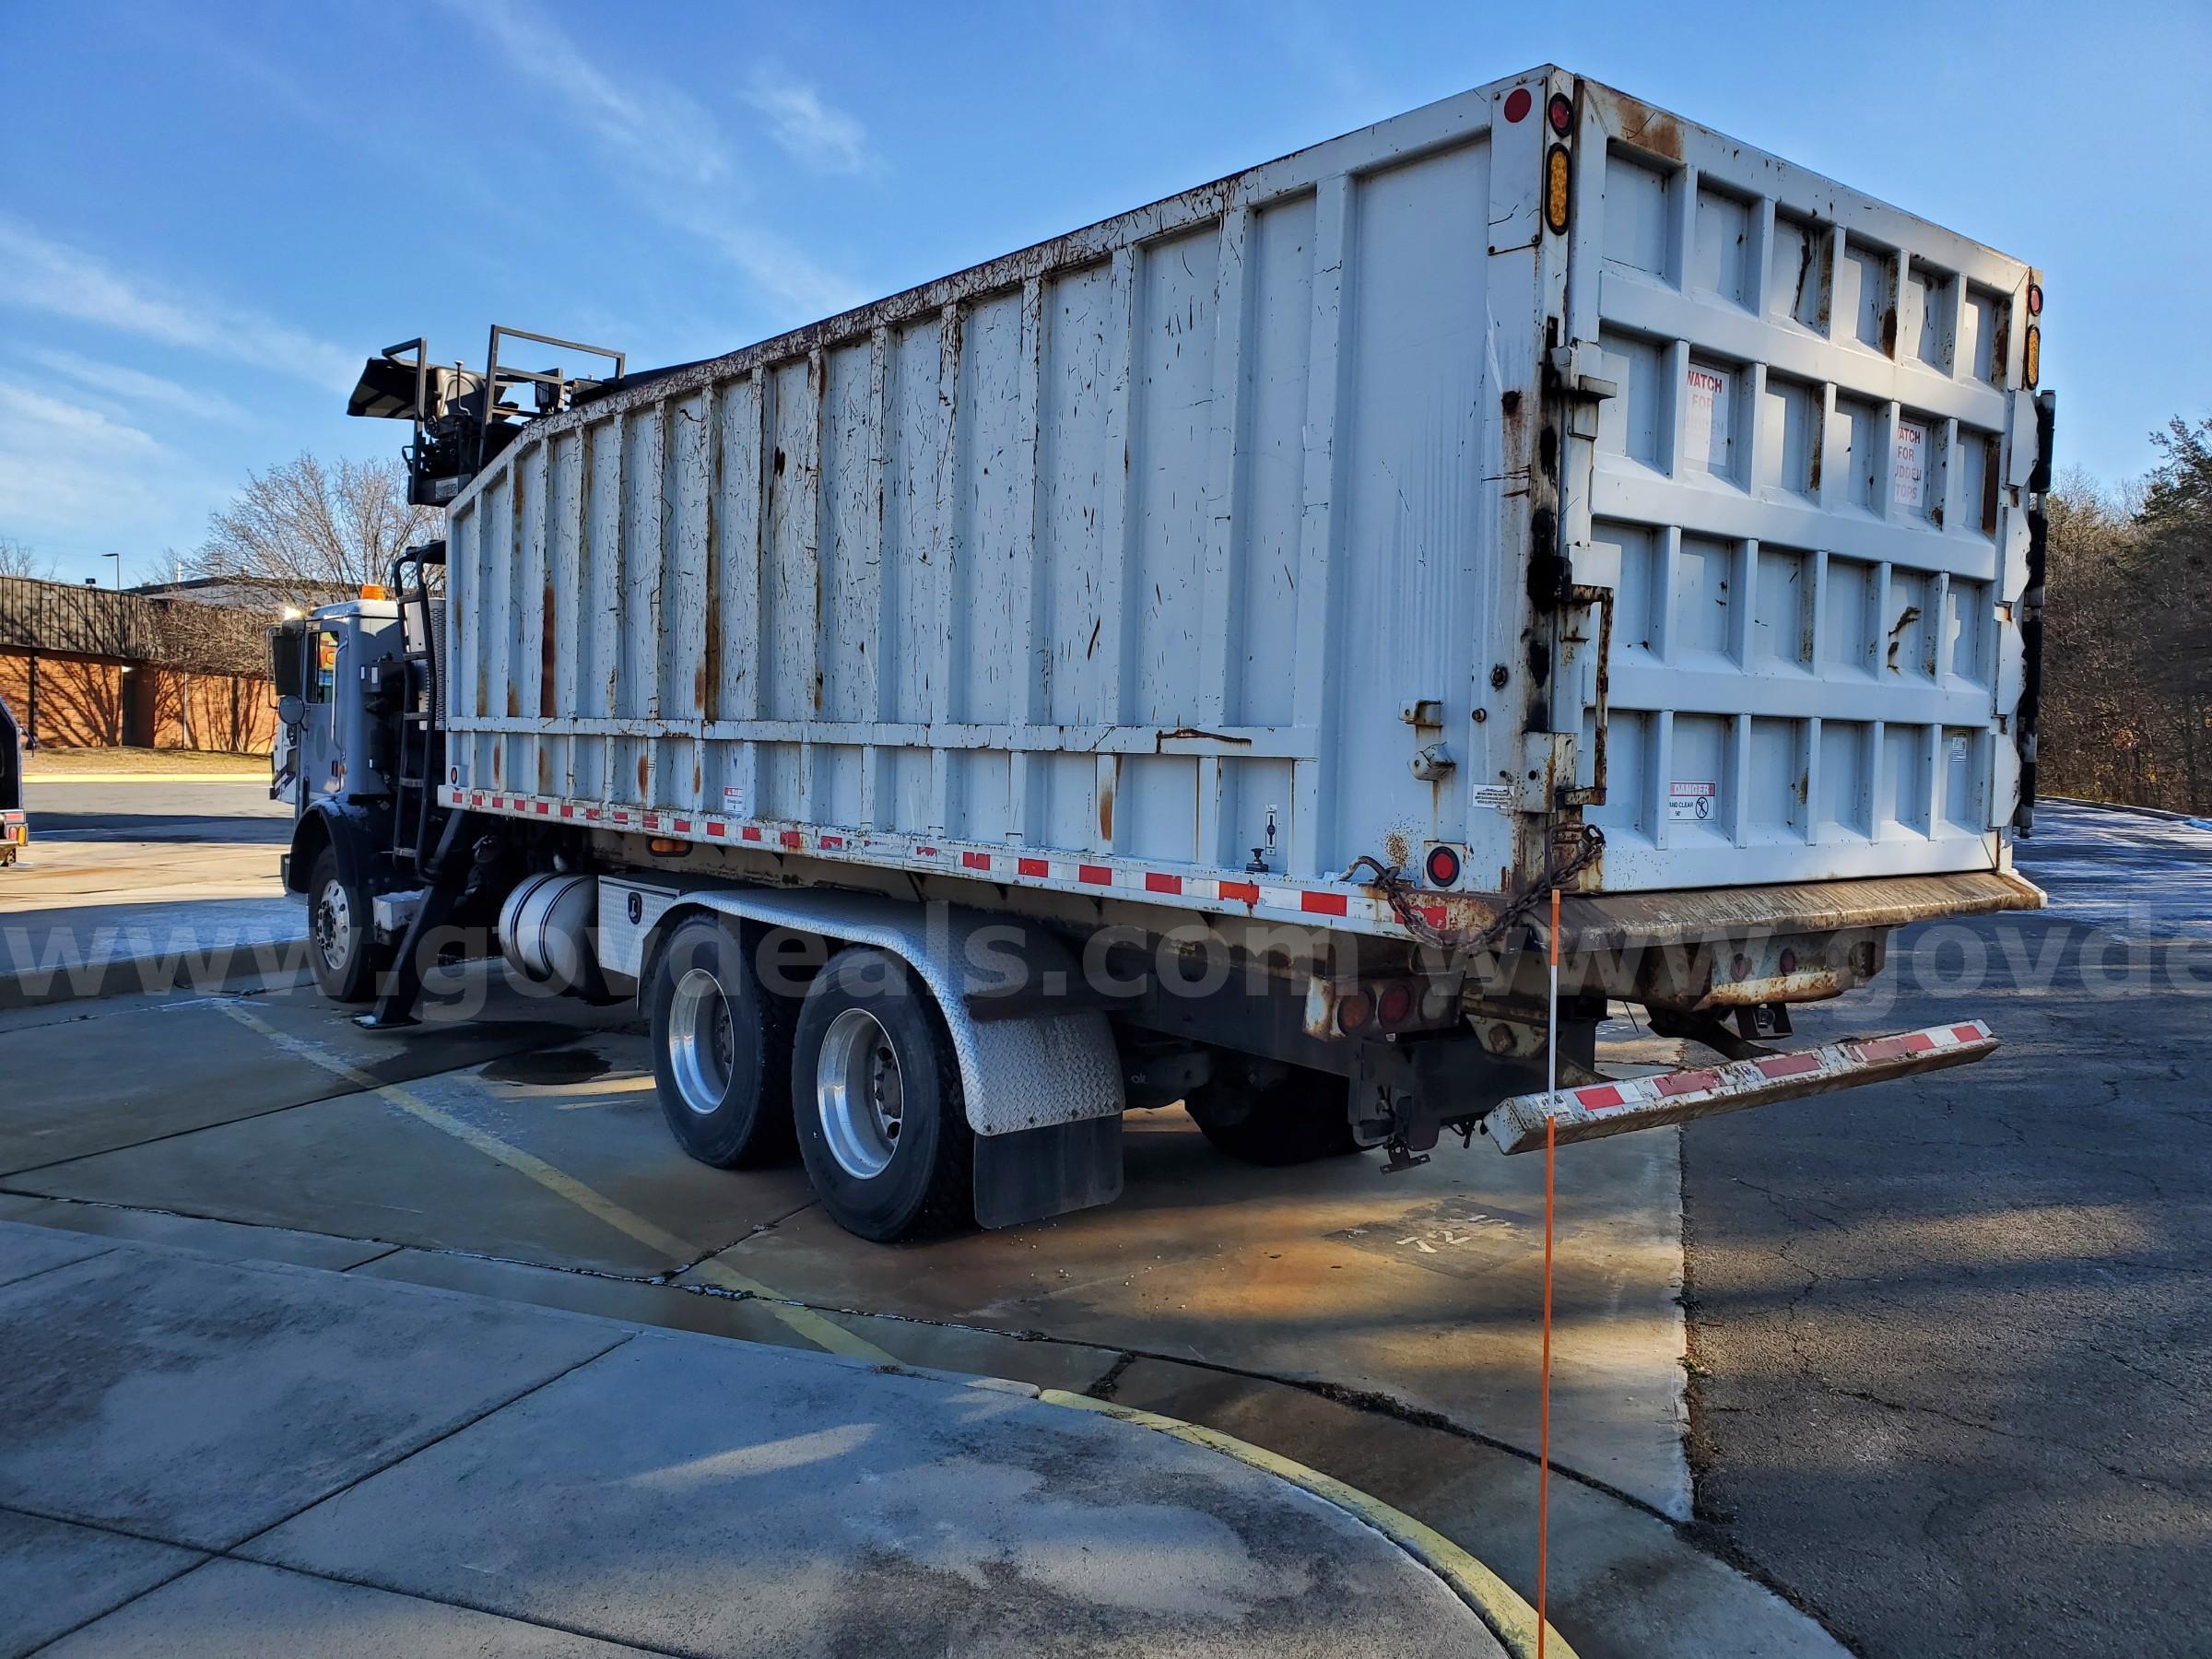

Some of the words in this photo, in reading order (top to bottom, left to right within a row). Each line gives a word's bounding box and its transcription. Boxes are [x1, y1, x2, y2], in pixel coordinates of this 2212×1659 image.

[1898, 427, 1921, 444] ATCH
[1897, 445, 1915, 462] FOR
[1895, 483, 1917, 500] TOPS
[1674, 783, 1710, 795] DANGER
